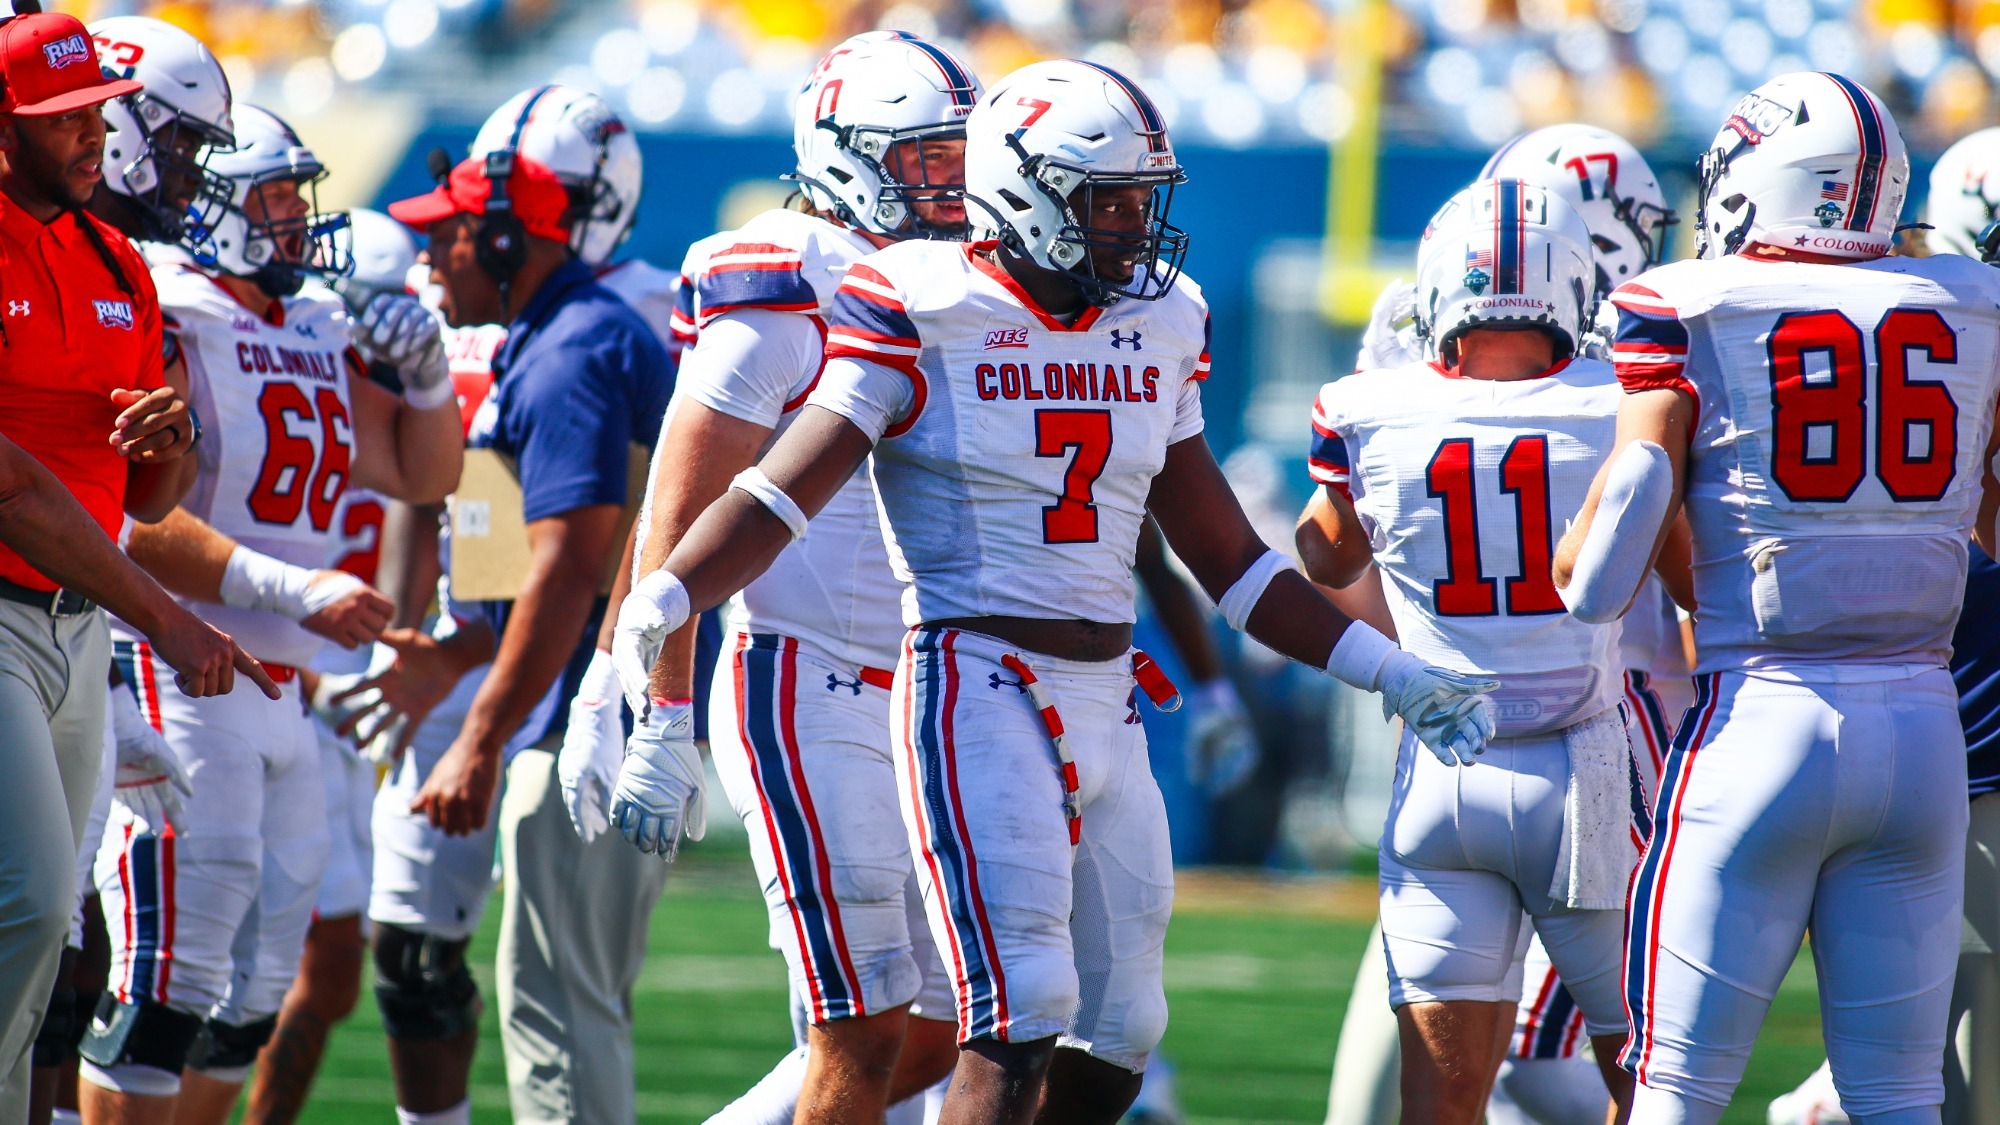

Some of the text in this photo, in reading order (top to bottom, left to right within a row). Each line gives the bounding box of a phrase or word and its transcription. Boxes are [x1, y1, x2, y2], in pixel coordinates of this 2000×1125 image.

[43, 34, 88, 66] RMU
[1005, 97, 1052, 147] 7
[1565, 152, 1617, 201] 17
[1814, 236, 1886, 254] COLONIALS
[93, 300, 132, 322] RMU
[1475, 298, 1543, 309] COLONIALS
[984, 328, 1028, 346] NEC
[975, 363, 1160, 403] COLONIALS
[1766, 308, 1958, 503] 86
[246, 381, 351, 531] 66
[1034, 408, 1113, 544] 7
[1425, 434, 1569, 617] 11
